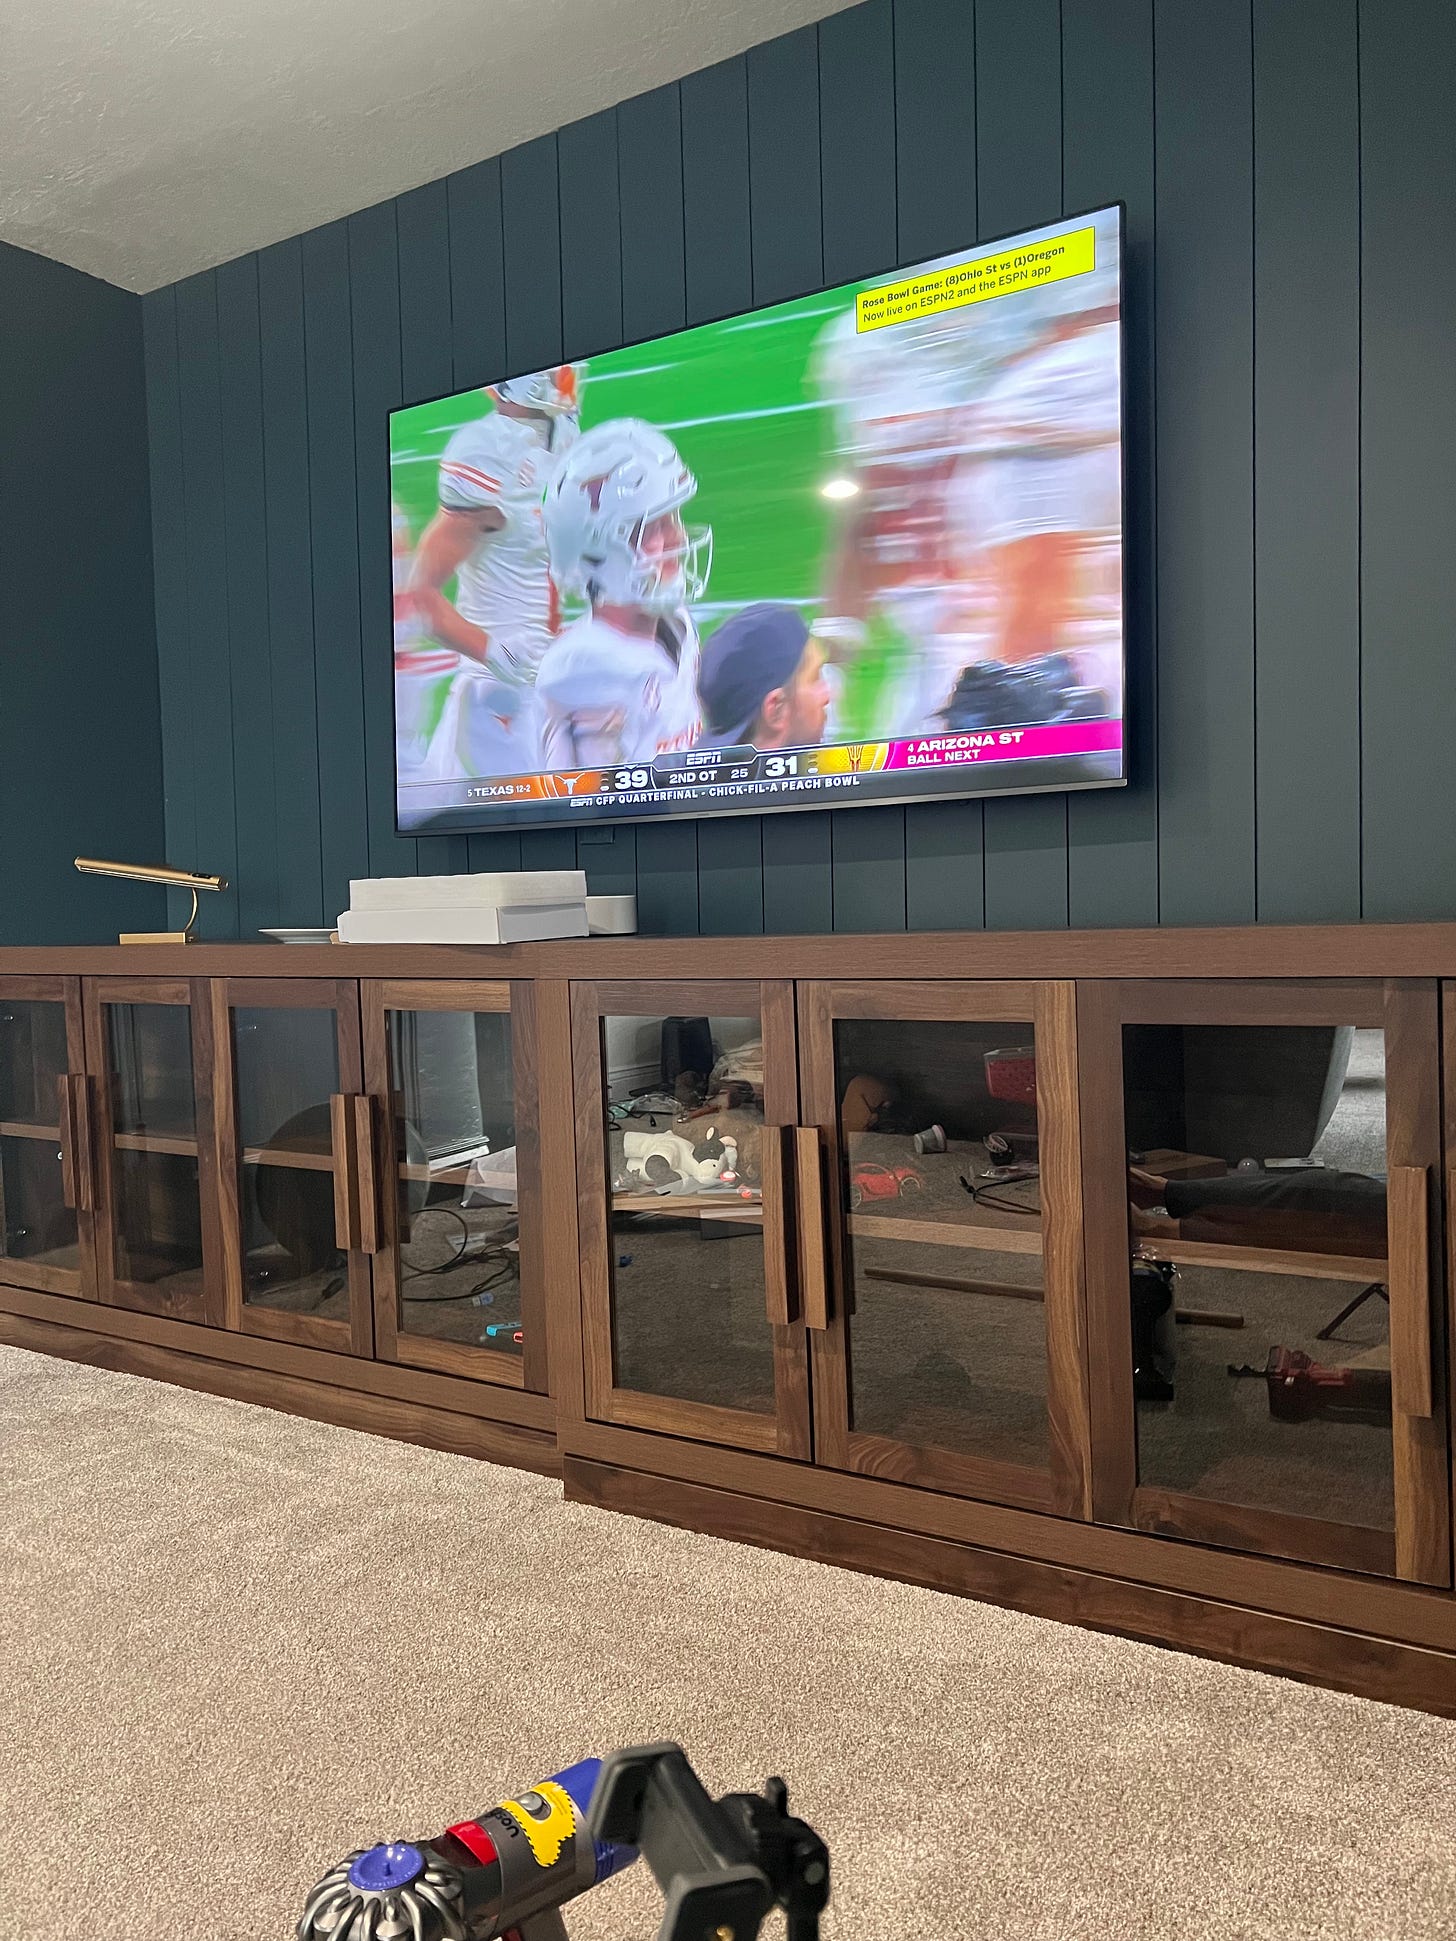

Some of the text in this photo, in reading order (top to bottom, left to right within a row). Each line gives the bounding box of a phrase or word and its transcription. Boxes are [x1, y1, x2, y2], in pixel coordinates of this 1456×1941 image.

[863, 297, 884, 308] Rose
[888, 288, 909, 301] Bowl
[913, 280, 942, 295] Game:
[986, 264, 997, 274] St
[1000, 261, 1010, 271] vs
[1014, 247, 1065, 268] (1)Oregon
[864, 265, 1051, 322] Now live on ESPN2 and the ESPN app
[908, 731, 1024, 752] 4 ARIZONA ST
[686, 752, 721, 766] ESPN
[765, 756, 797, 776] 31
[907, 750, 980, 765] BALL NEXT
[615, 770, 648, 790] 39
[670, 770, 717, 784] 2ND OT
[731, 769, 748, 779] 25
[468, 784, 530, 797] 5 TEXAS 12-2
[570, 798, 593, 807] ESPN
[596, 796, 616, 805] CFP
[618, 789, 698, 804] QUARTERFINAL
[709, 782, 778, 797] CHICK-FIL-A
[781, 777, 821, 791] PEACH
[825, 776, 860, 787] BOWL
